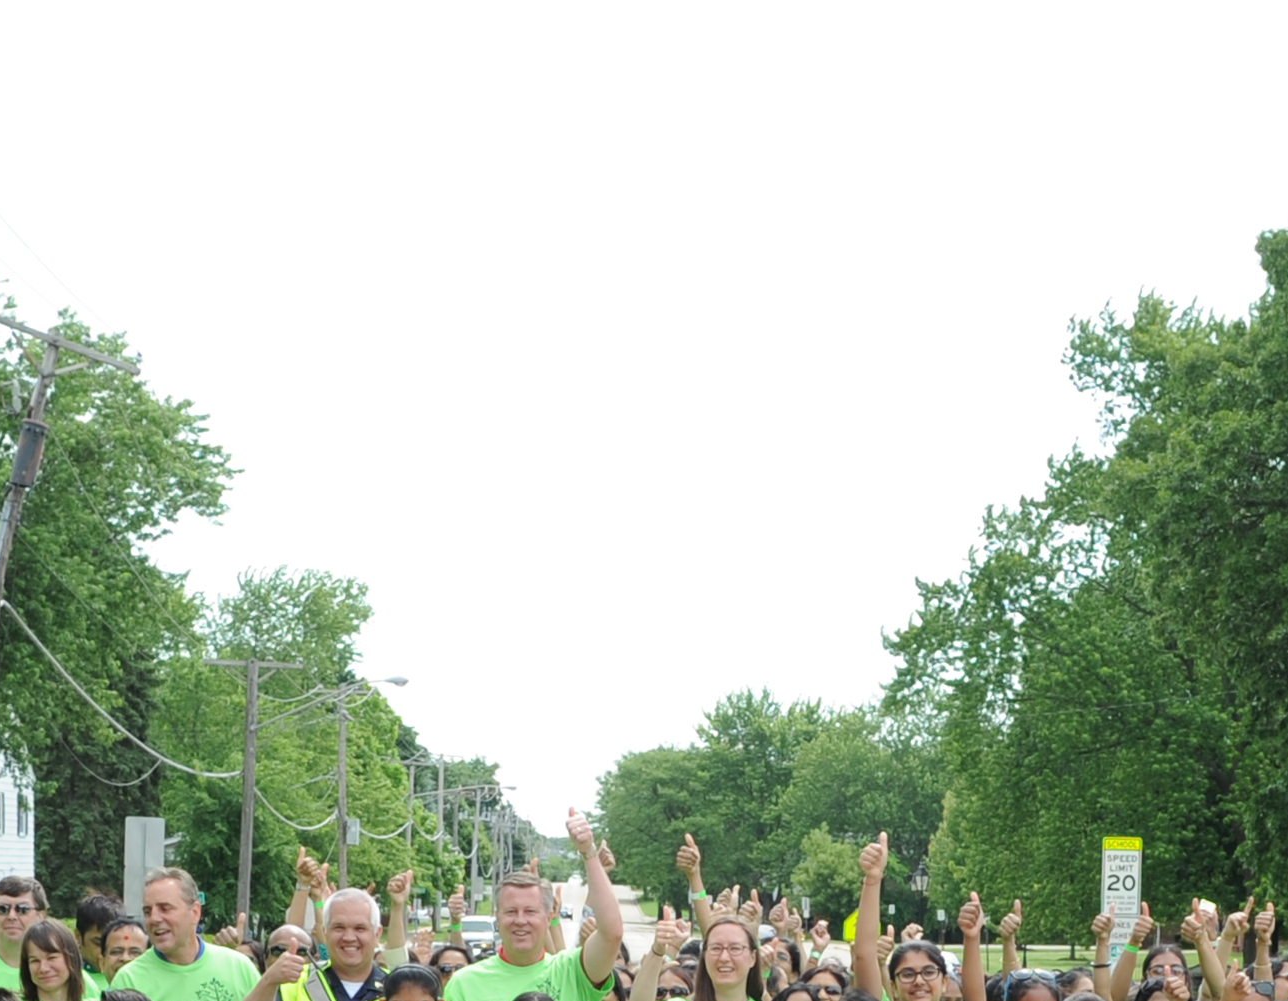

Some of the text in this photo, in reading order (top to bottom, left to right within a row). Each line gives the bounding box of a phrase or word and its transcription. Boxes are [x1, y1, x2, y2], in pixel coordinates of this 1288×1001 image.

[1107, 840, 1137, 849] SCHOOL
[1107, 854, 1137, 862] SPEED
[1107, 874, 1136, 891] 20
